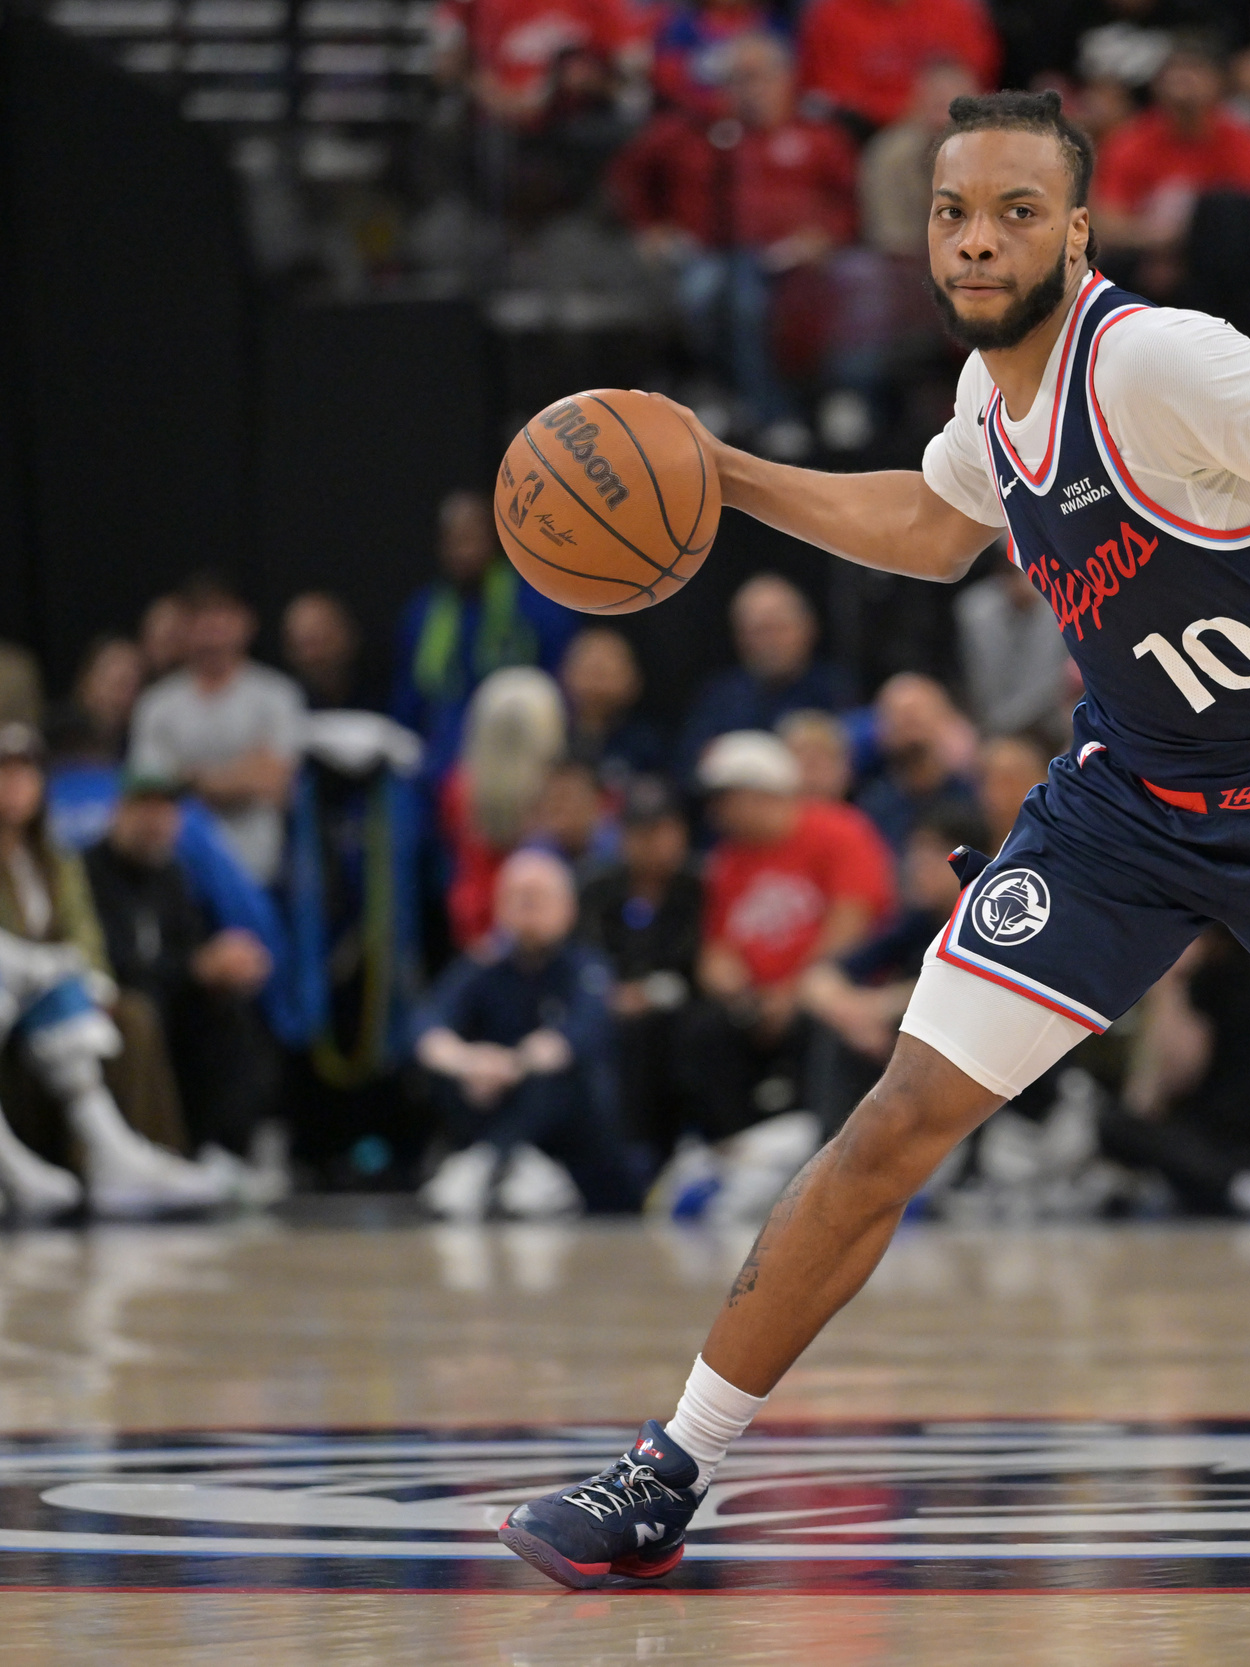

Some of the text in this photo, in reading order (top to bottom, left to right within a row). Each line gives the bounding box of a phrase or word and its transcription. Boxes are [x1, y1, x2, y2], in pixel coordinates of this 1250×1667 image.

[538, 399, 630, 512] Wilson
[1059, 485, 1112, 516] RWANDA
[1062, 477, 1093, 499] VISIT
